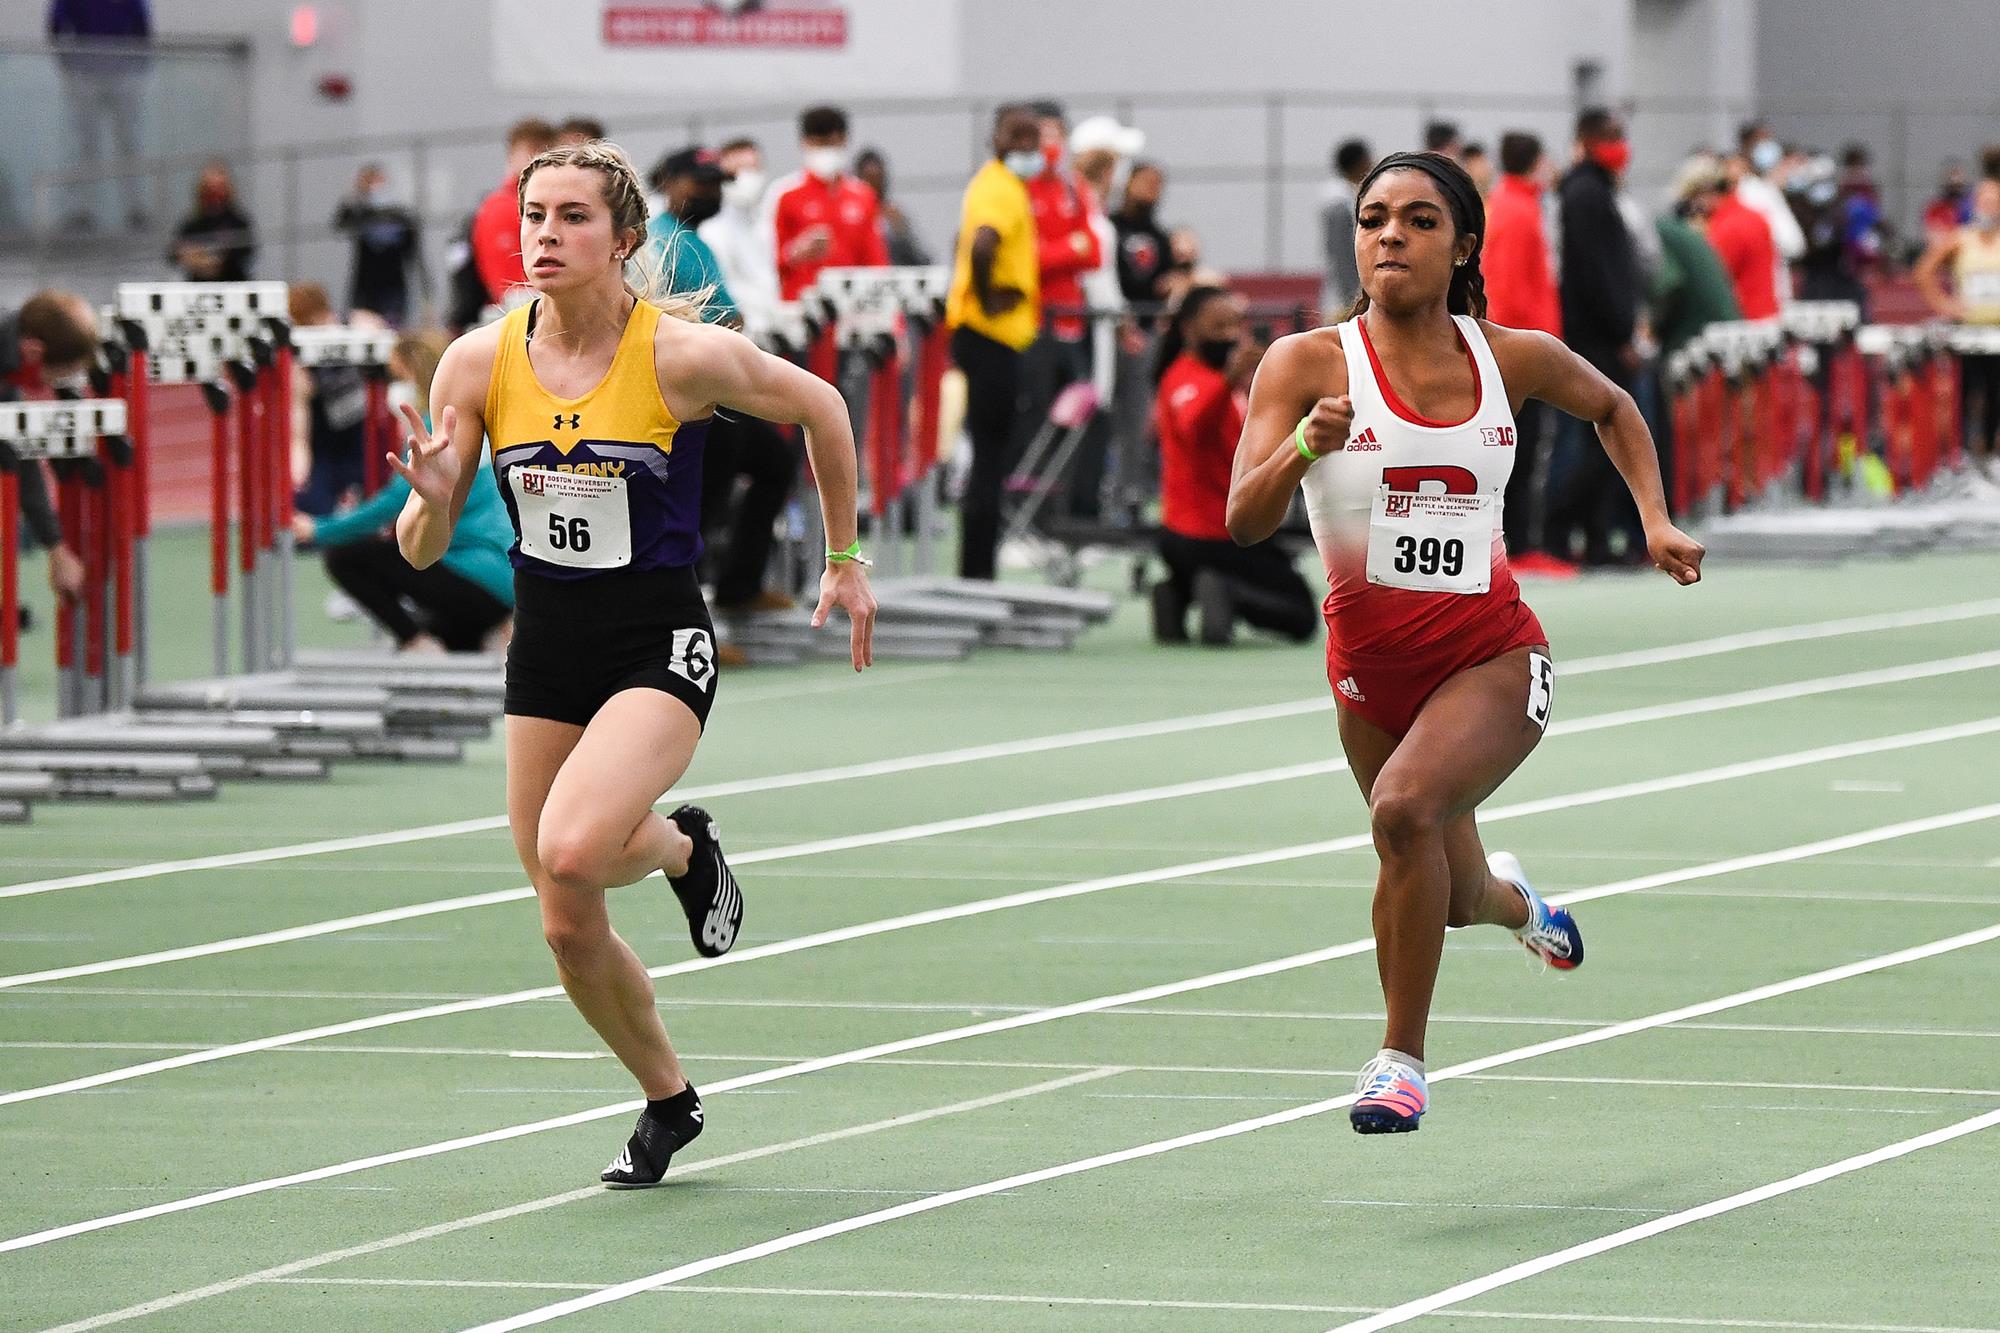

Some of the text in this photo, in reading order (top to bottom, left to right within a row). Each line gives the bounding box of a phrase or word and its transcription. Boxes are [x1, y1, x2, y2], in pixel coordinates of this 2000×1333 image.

[1347, 442, 1382, 452] adidas
[547, 475, 612, 487] BOSTON UNIVERSITY
[557, 491, 601, 499] INVITATIONAL
[1442, 497, 1481, 505] UNIVERSITY
[549, 512, 591, 552] 56
[1394, 535, 1465, 577] 399
[682, 631, 710, 681] 6
[1535, 659, 1552, 721] 5
